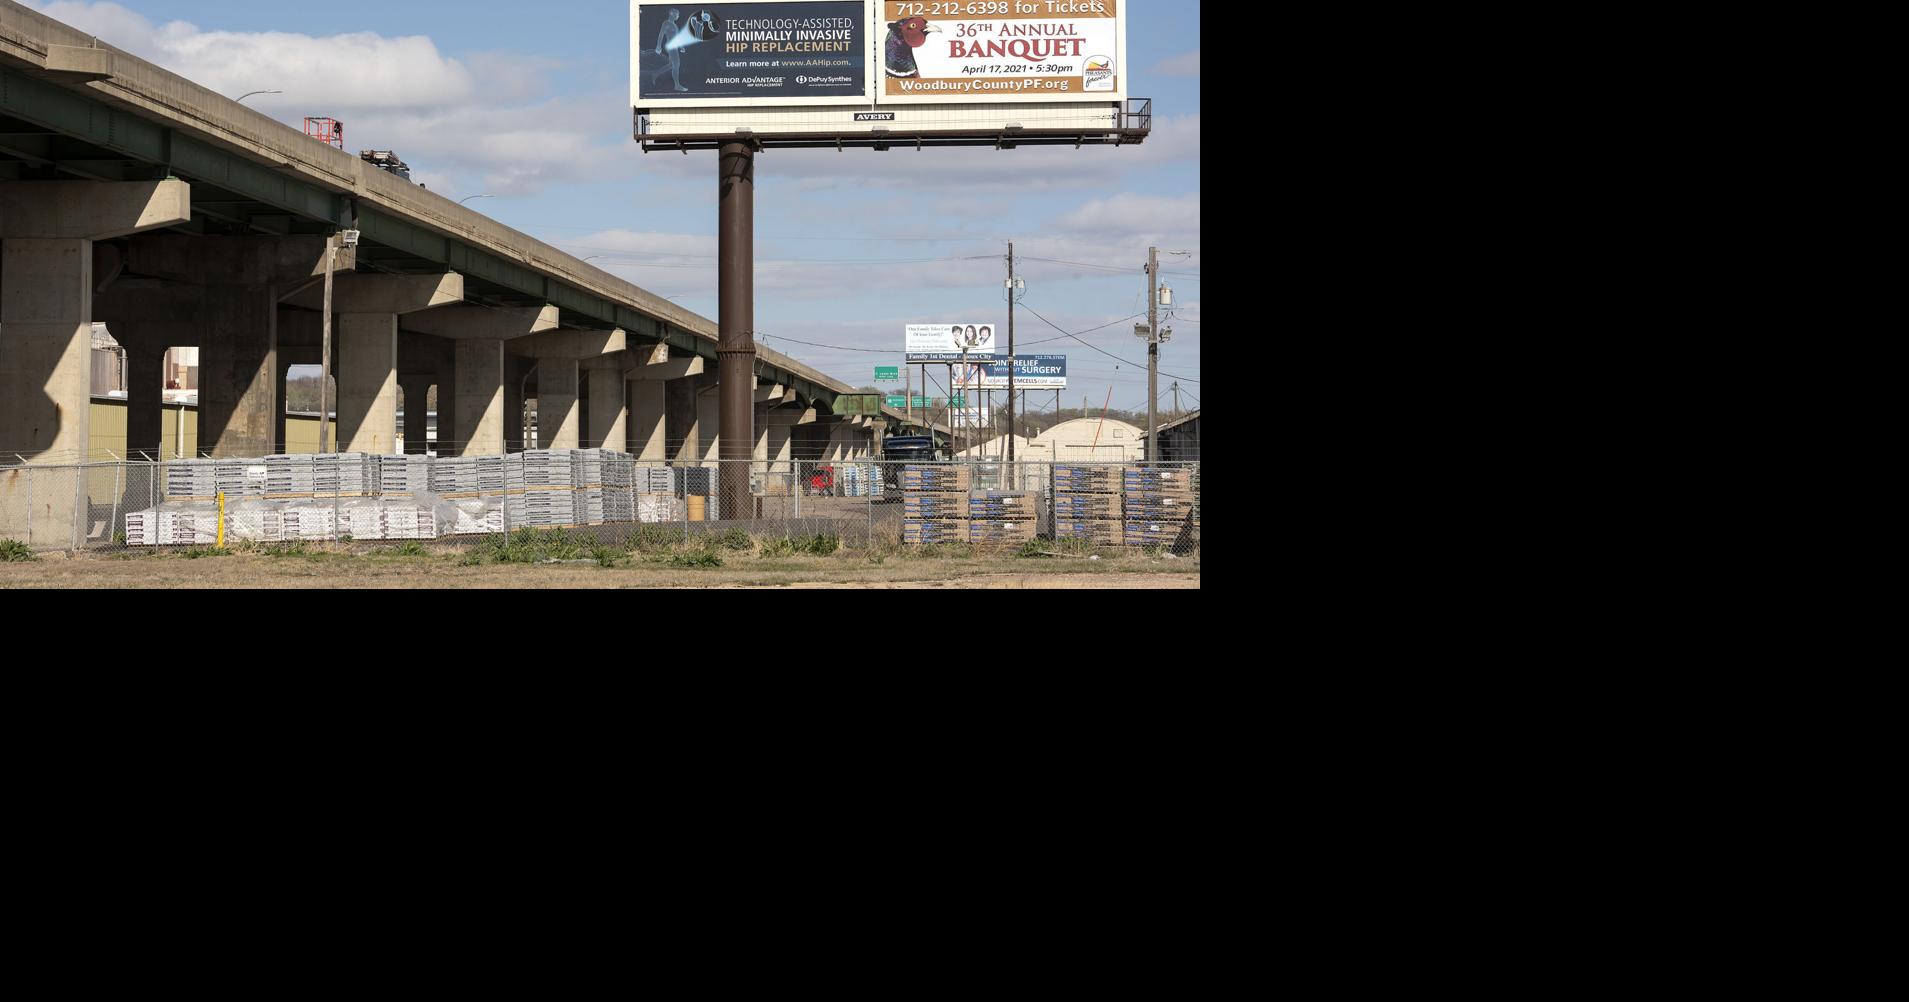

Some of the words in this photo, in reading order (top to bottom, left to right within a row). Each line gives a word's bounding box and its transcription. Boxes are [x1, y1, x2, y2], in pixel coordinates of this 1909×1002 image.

[897, 1, 1009, 16] 712-212-6398
[1015, 1, 1042, 14] for
[1046, 0, 1105, 13] Tickets
[725, 18, 855, 30] TECHNOLOGY-ASSISTED,
[725, 30, 791, 42] MINIMALLY
[796, 30, 851, 41] INVASIVE
[956, 23, 993, 38] 36TH
[998, 23, 1078, 37] ANNUAL
[725, 42, 749, 53] HIP
[753, 41, 851, 53] REPLACEMENT
[948, 38, 1086, 62] BANQUET
[961, 65, 987, 75] April
[989, 65, 1002, 74] 17,
[1004, 64, 1027, 73] 2021
[1036, 64, 1073, 75] 5:30pm
[808, 76, 827, 84] DePuy
[828, 76, 852, 84] Synthes
[900, 79, 1069, 92] WoodburyCountyPF.org
[1013, 359, 1039, 367] RELIEF
[1021, 366, 1062, 374] SURGERY
